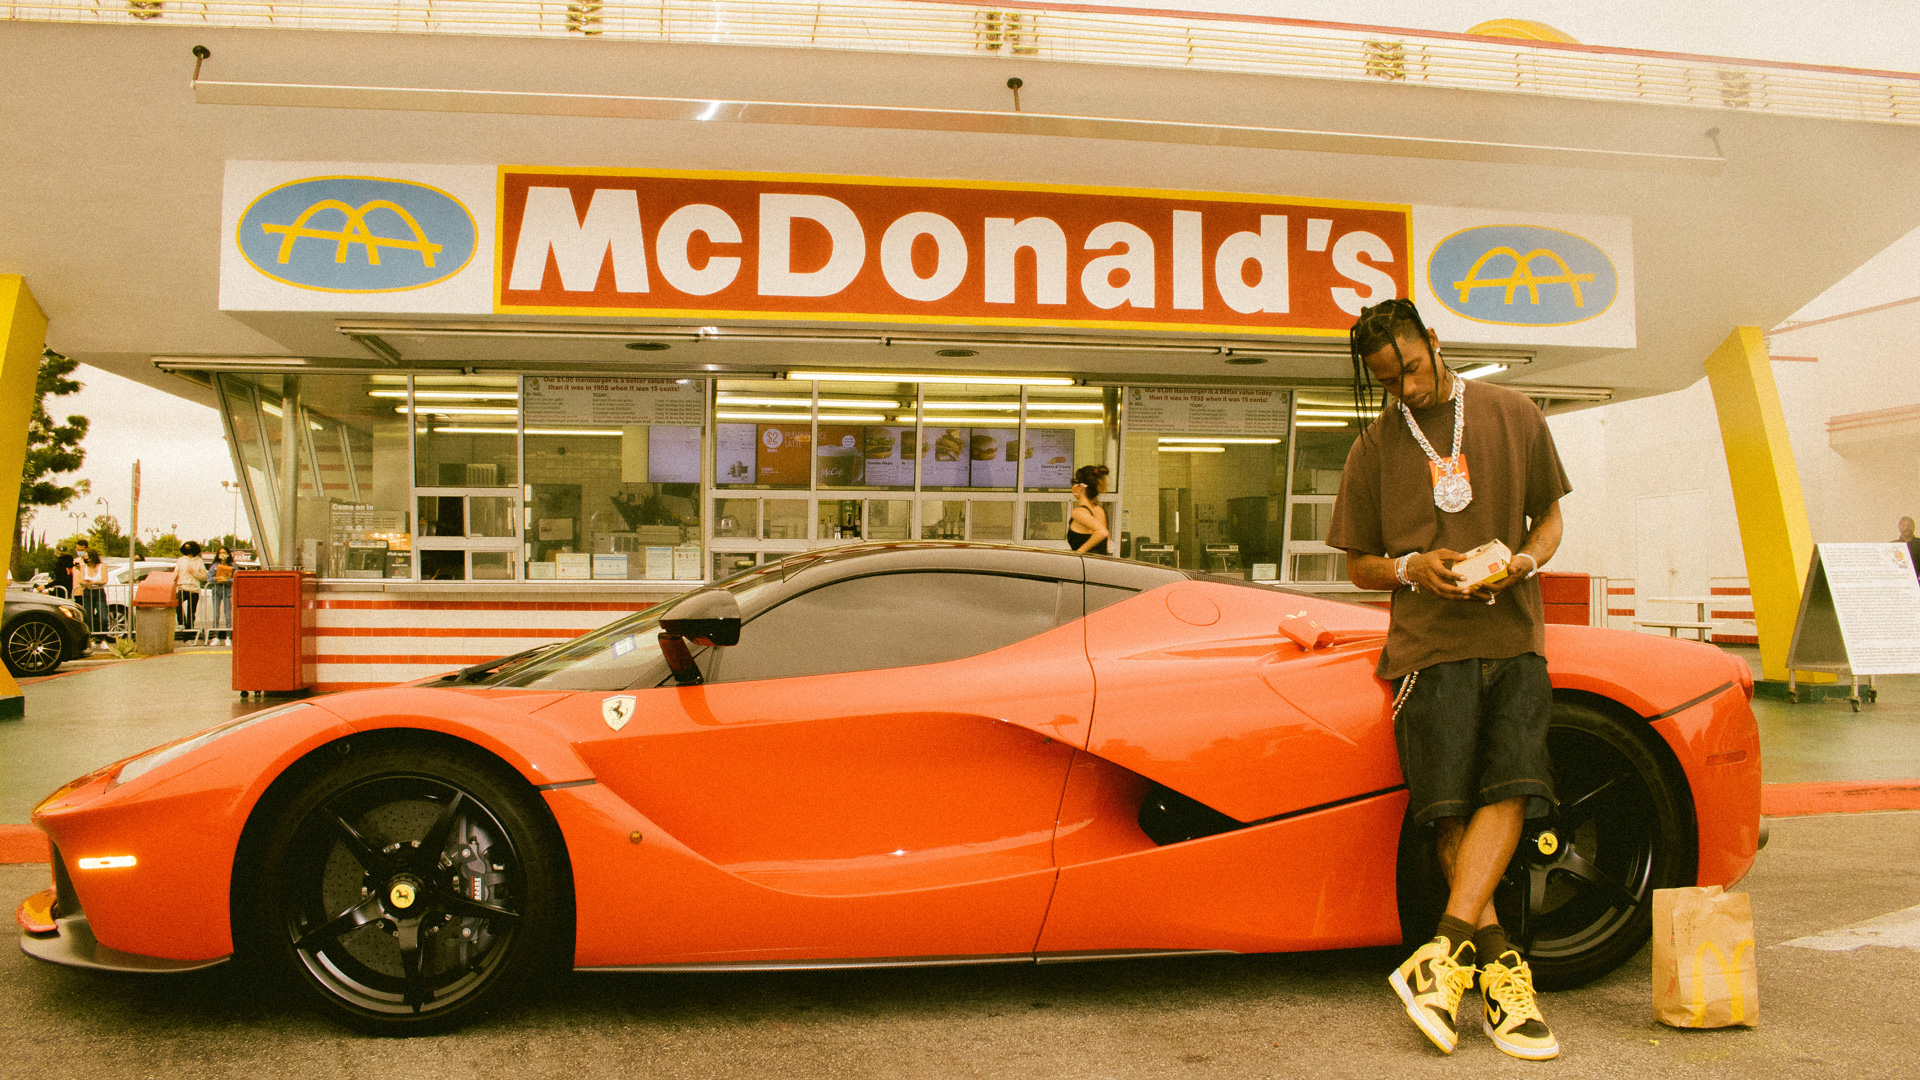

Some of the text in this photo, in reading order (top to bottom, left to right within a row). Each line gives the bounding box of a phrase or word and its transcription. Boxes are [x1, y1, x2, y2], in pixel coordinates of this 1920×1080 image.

[508, 185, 1398, 318] McDonald's
[766, 430, 779, 443] $2
[332, 503, 355, 511] Come
[366, 503, 375, 511] in
